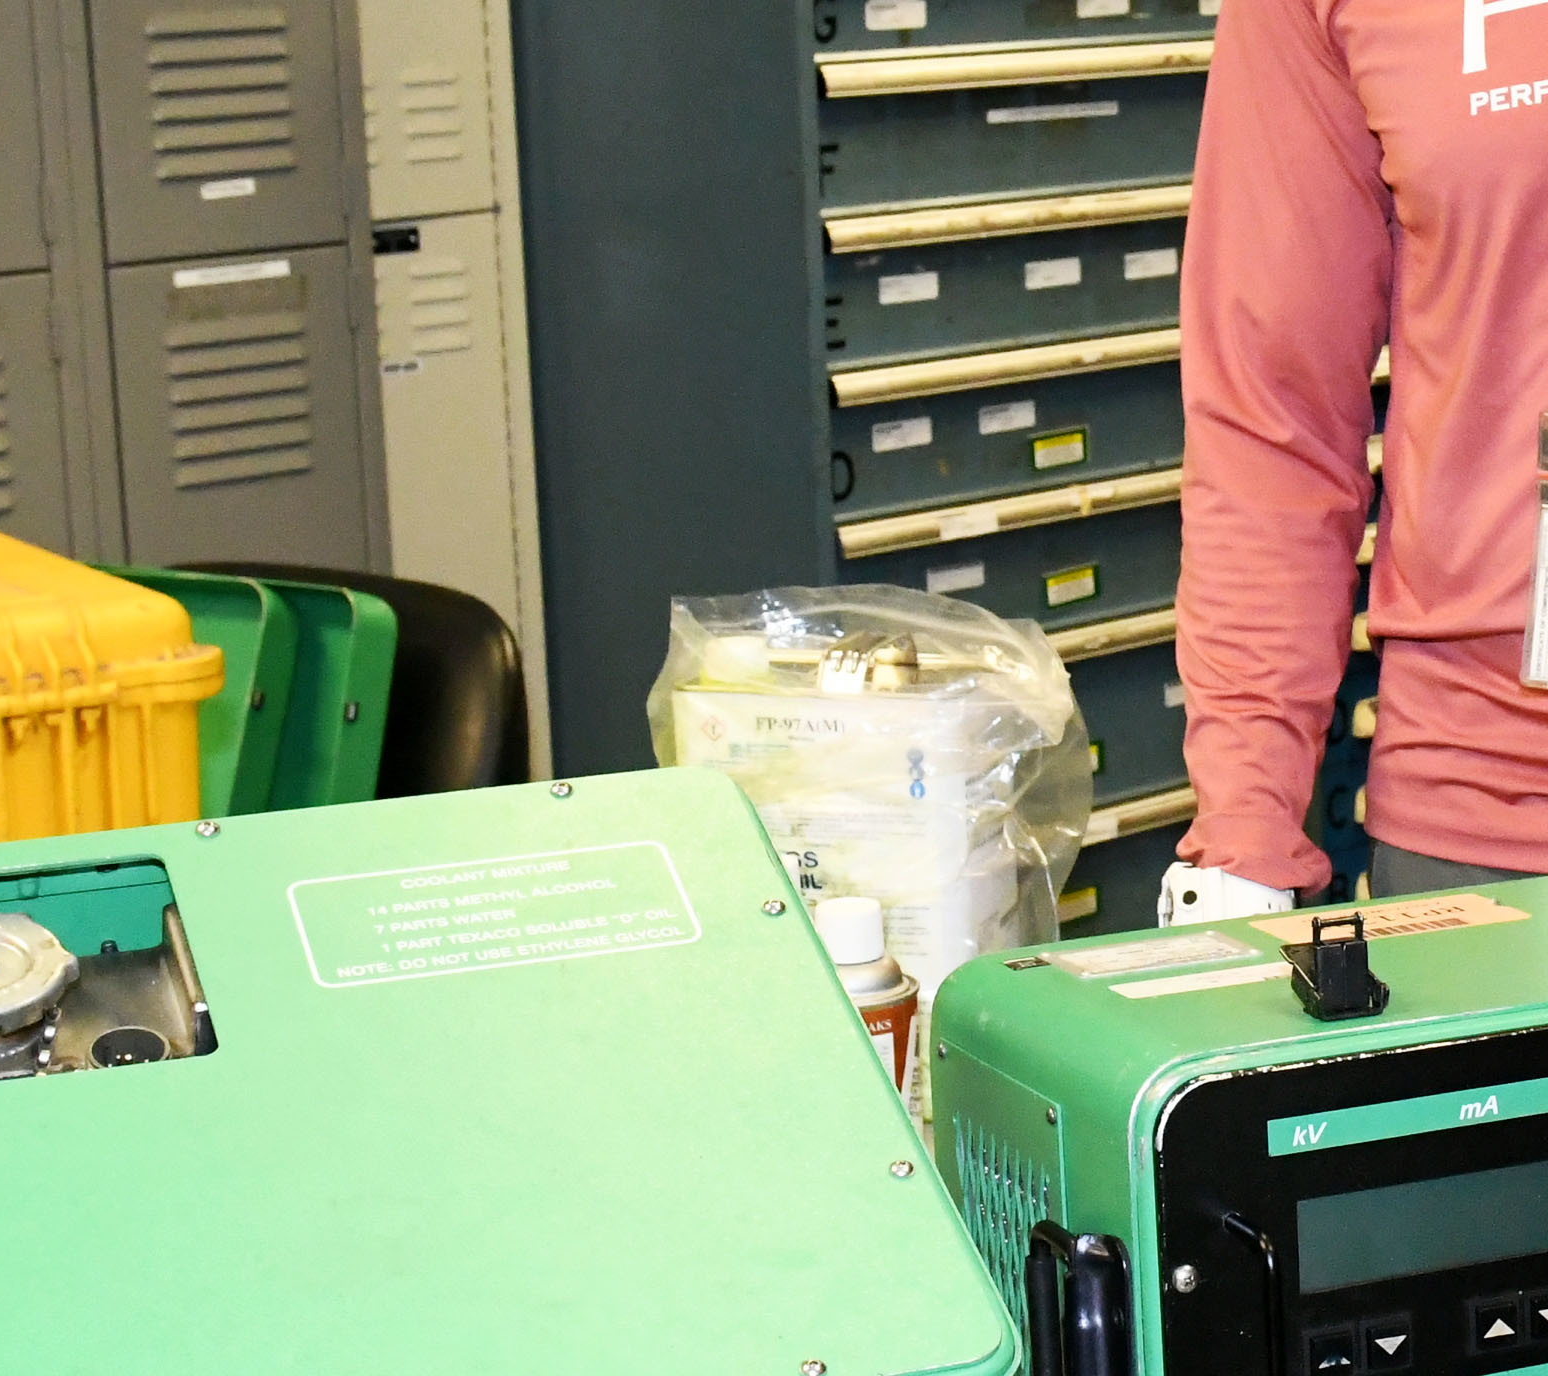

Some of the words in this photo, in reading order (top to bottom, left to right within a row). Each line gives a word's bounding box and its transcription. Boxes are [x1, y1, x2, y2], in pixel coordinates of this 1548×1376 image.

[399, 870, 487, 890] COOLANT
[492, 860, 571, 880] MIXTURE
[368, 904, 387, 916] 14
[392, 896, 451, 913] PARTS
[455, 887, 527, 907] METHYL
[531, 878, 617, 899] ALCOHOL
[374, 924, 385, 935] 7
[390, 917, 449, 934] PARTS
[453, 909, 517, 926] WATER
[381, 943, 391, 954] 1
[395, 937, 443, 953] PART
[447, 928, 521, 947] TEXACO
[525, 916, 608, 936] SOLUBLE
[336, 962, 396, 979] NOTE:
[399, 956, 428, 971] DO
[432, 952, 470, 967] NOT
[475, 947, 515, 963] USE
[517, 935, 613, 958] ETHYLENE
[615, 925, 685, 945] GLYCOL
[1459, 1095, 1499, 1121] mA
[1292, 1121, 1328, 1147] kV
